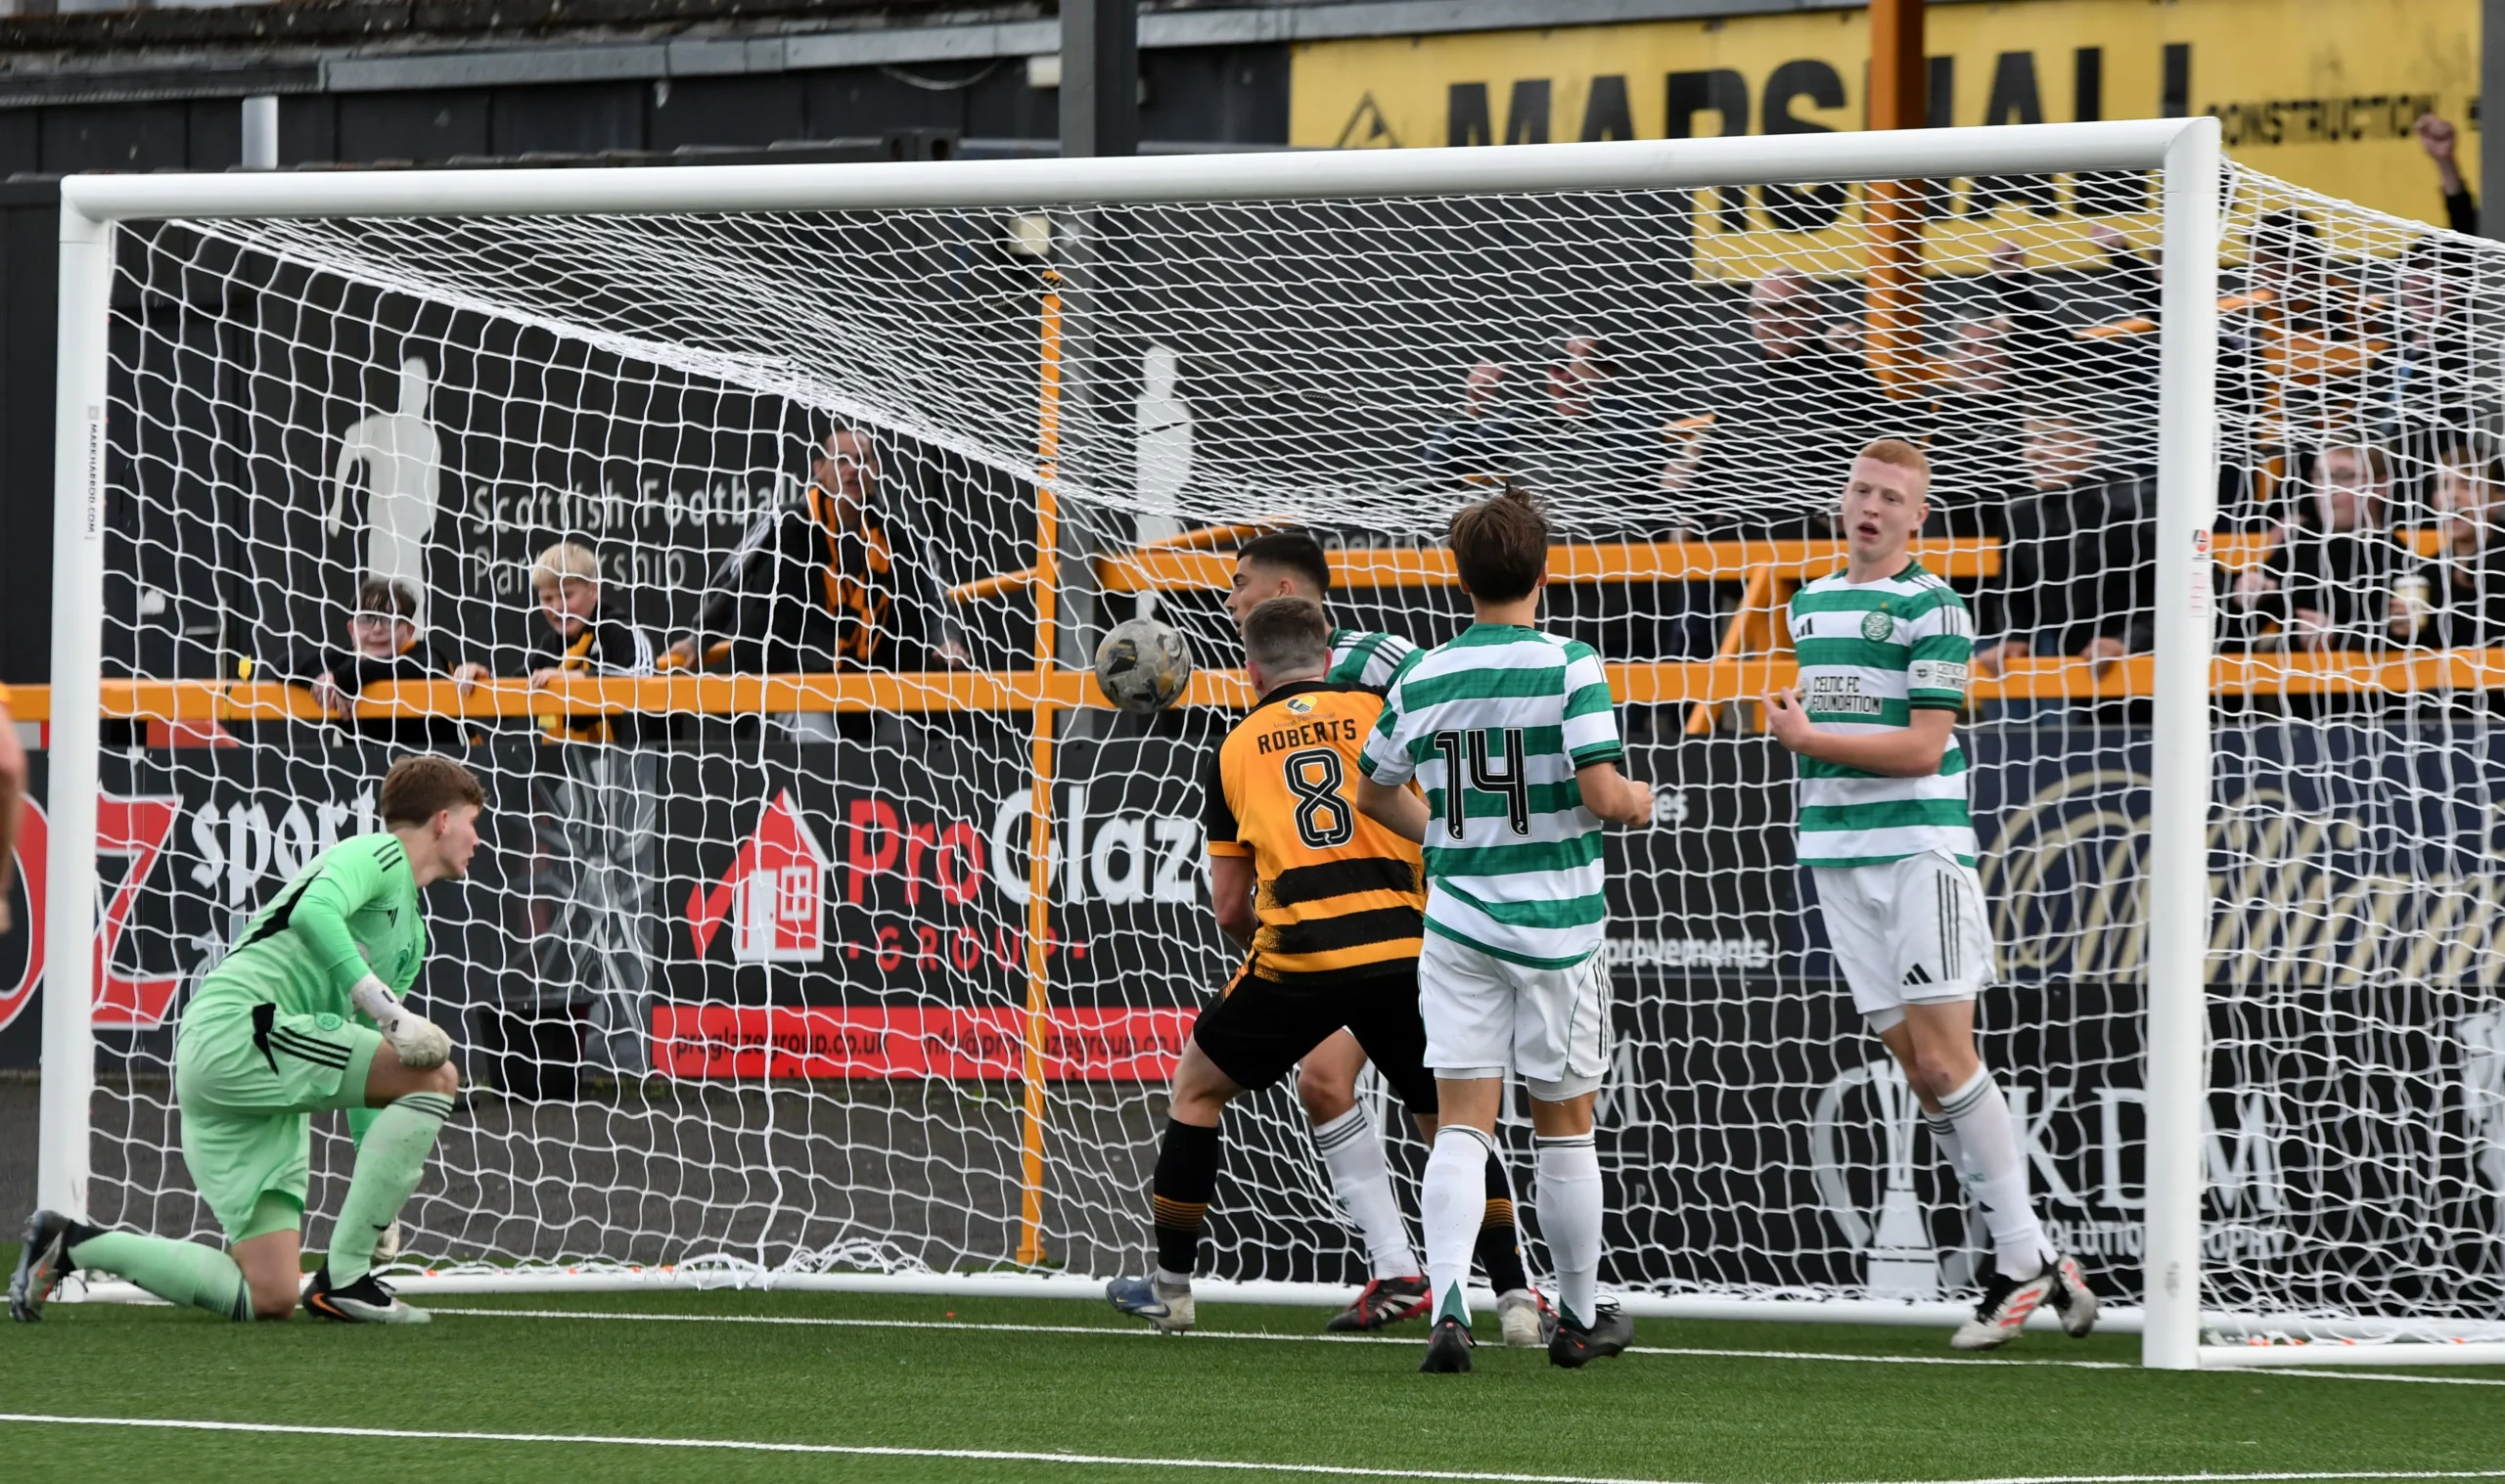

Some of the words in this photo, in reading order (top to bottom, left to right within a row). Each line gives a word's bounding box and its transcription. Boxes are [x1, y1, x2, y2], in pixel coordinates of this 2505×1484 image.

[1448, 43, 2235, 241] MARSALL
[474, 477, 626, 535] Scottish
[474, 542, 687, 597] Parrship
[1812, 696, 1882, 714] FOUNDATION
[1813, 676, 1844, 693] CELTIC
[1845, 676, 1860, 693] FC
[1257, 719, 1357, 755] ROBERTS
[1283, 746, 1354, 850] 8
[1434, 728, 1531, 842] 14
[847, 786, 1211, 906] ProGlaz
[1605, 937, 1769, 968] provements
[676, 1027, 888, 1061] proglazegroup.co.uk
